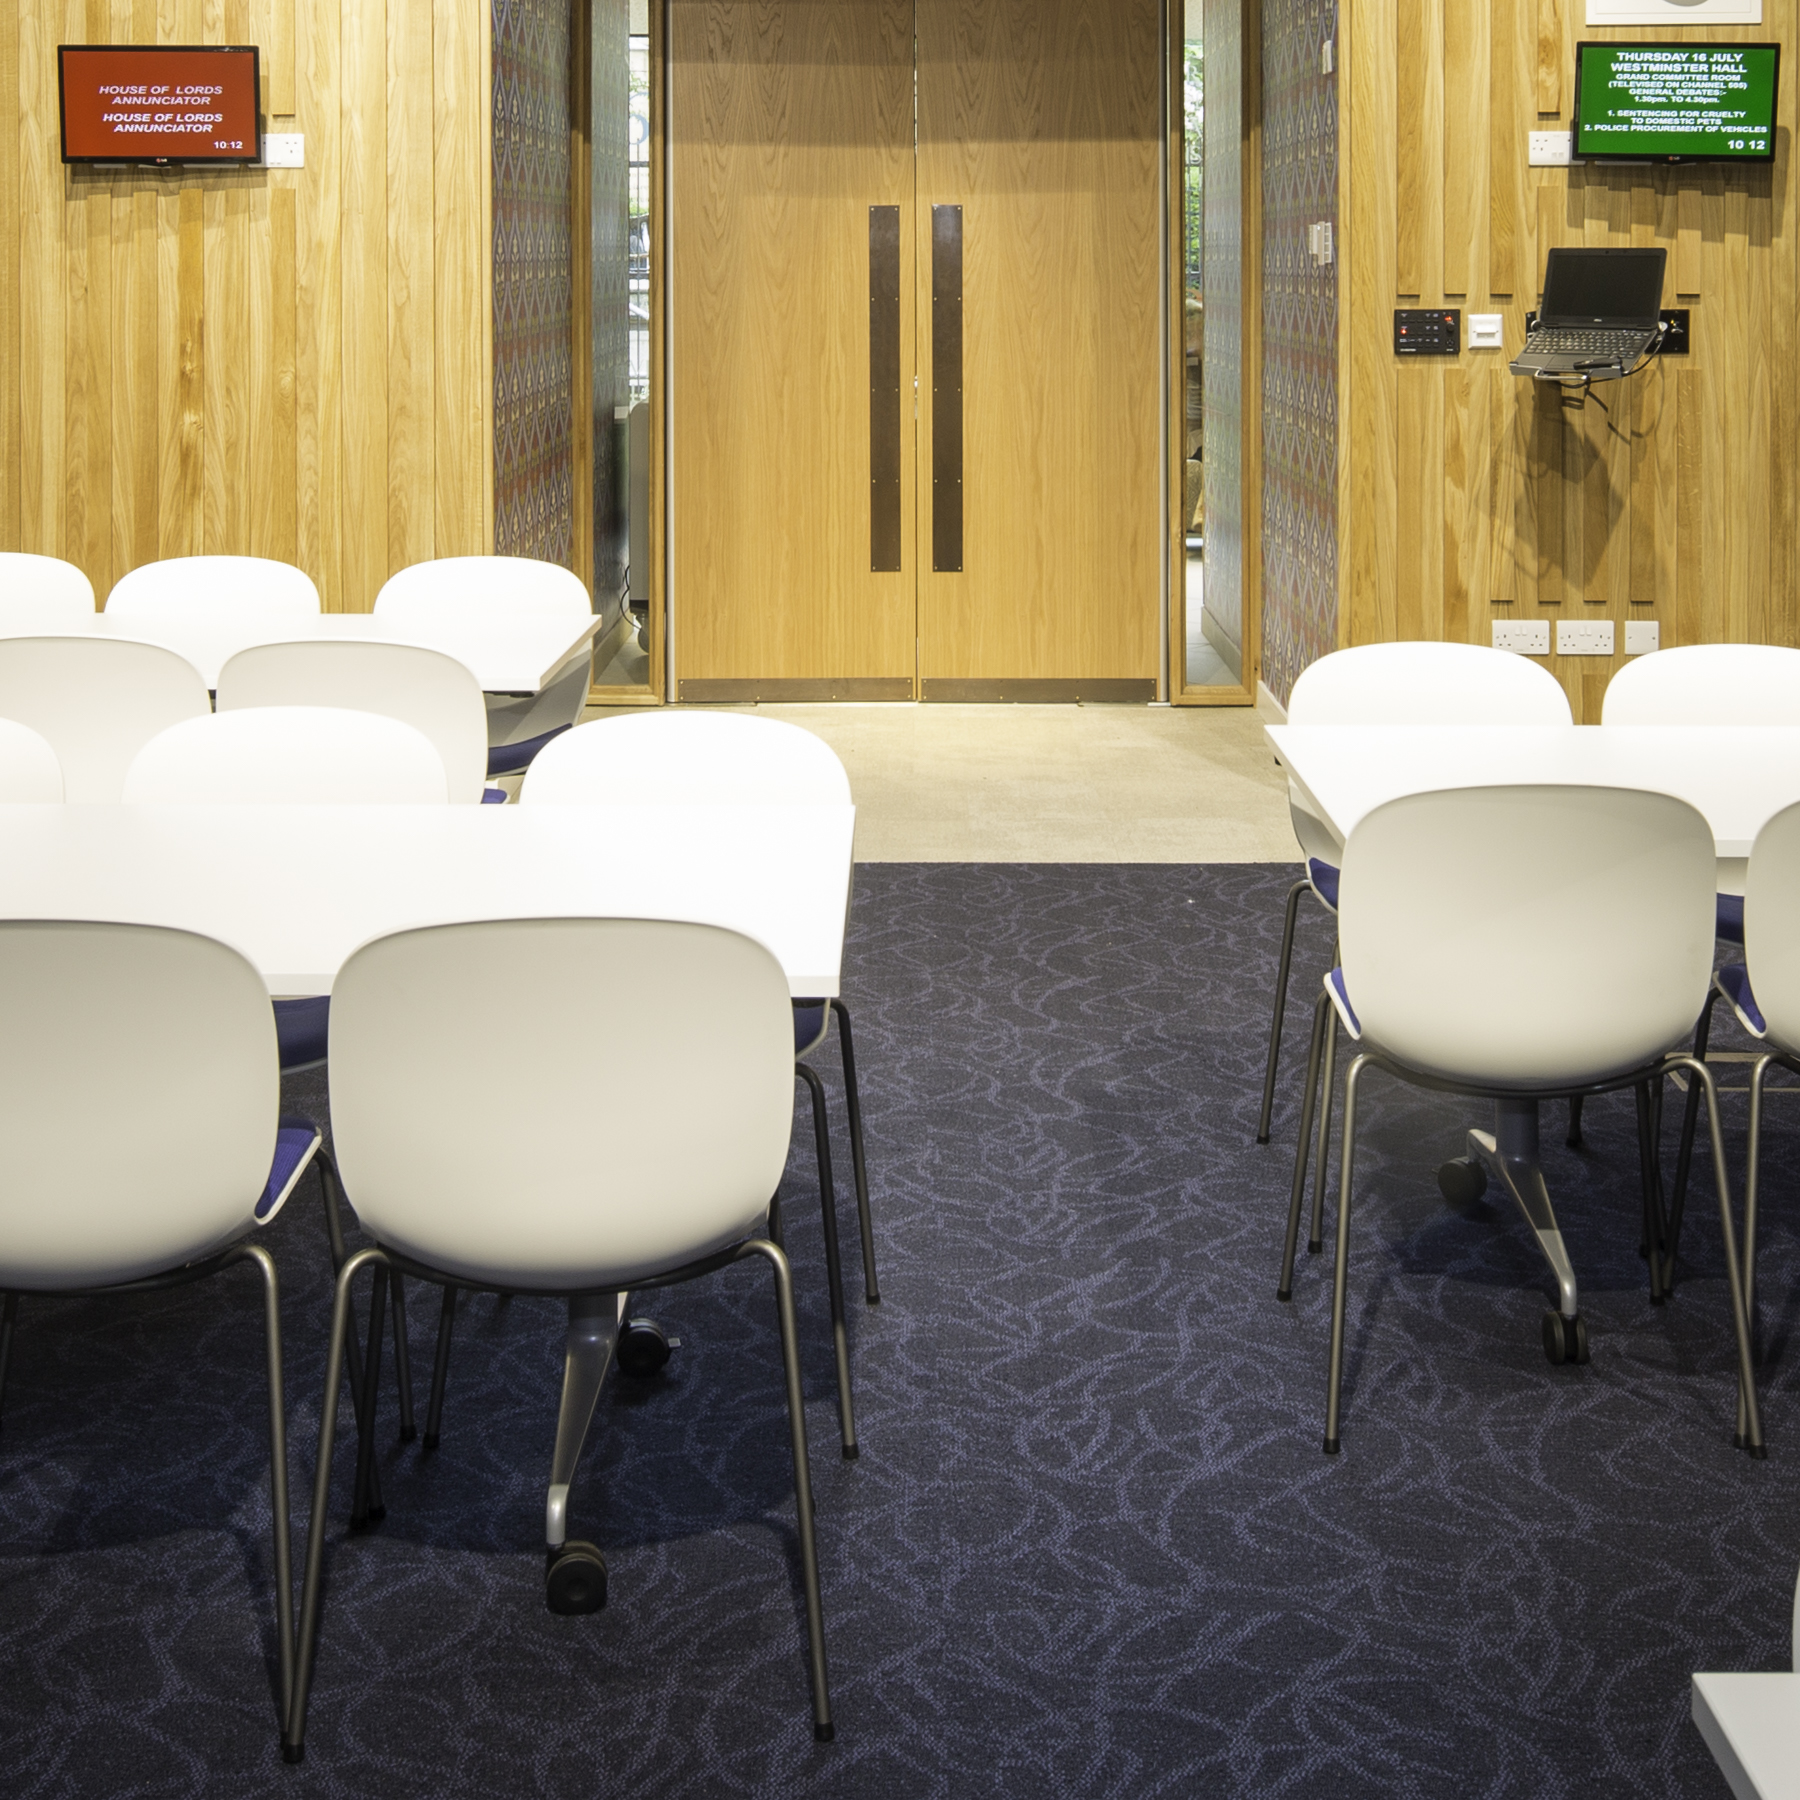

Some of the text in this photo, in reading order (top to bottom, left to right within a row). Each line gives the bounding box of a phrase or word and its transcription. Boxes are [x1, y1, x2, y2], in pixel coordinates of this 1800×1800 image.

[1617, 52, 1744, 63] THURSDAY 16 JULY
[1611, 63, 1748, 73] WESTMINSTER HALL
[1608, 81, 1664, 89] (TELEVISED
[99, 86, 223, 95] HOUSE OF LORDS
[112, 97, 211, 105] ANNUNCIATOR
[103, 114, 223, 122] HOUSE OF LORDS
[114, 124, 213, 133] ANNUNCIATOR
